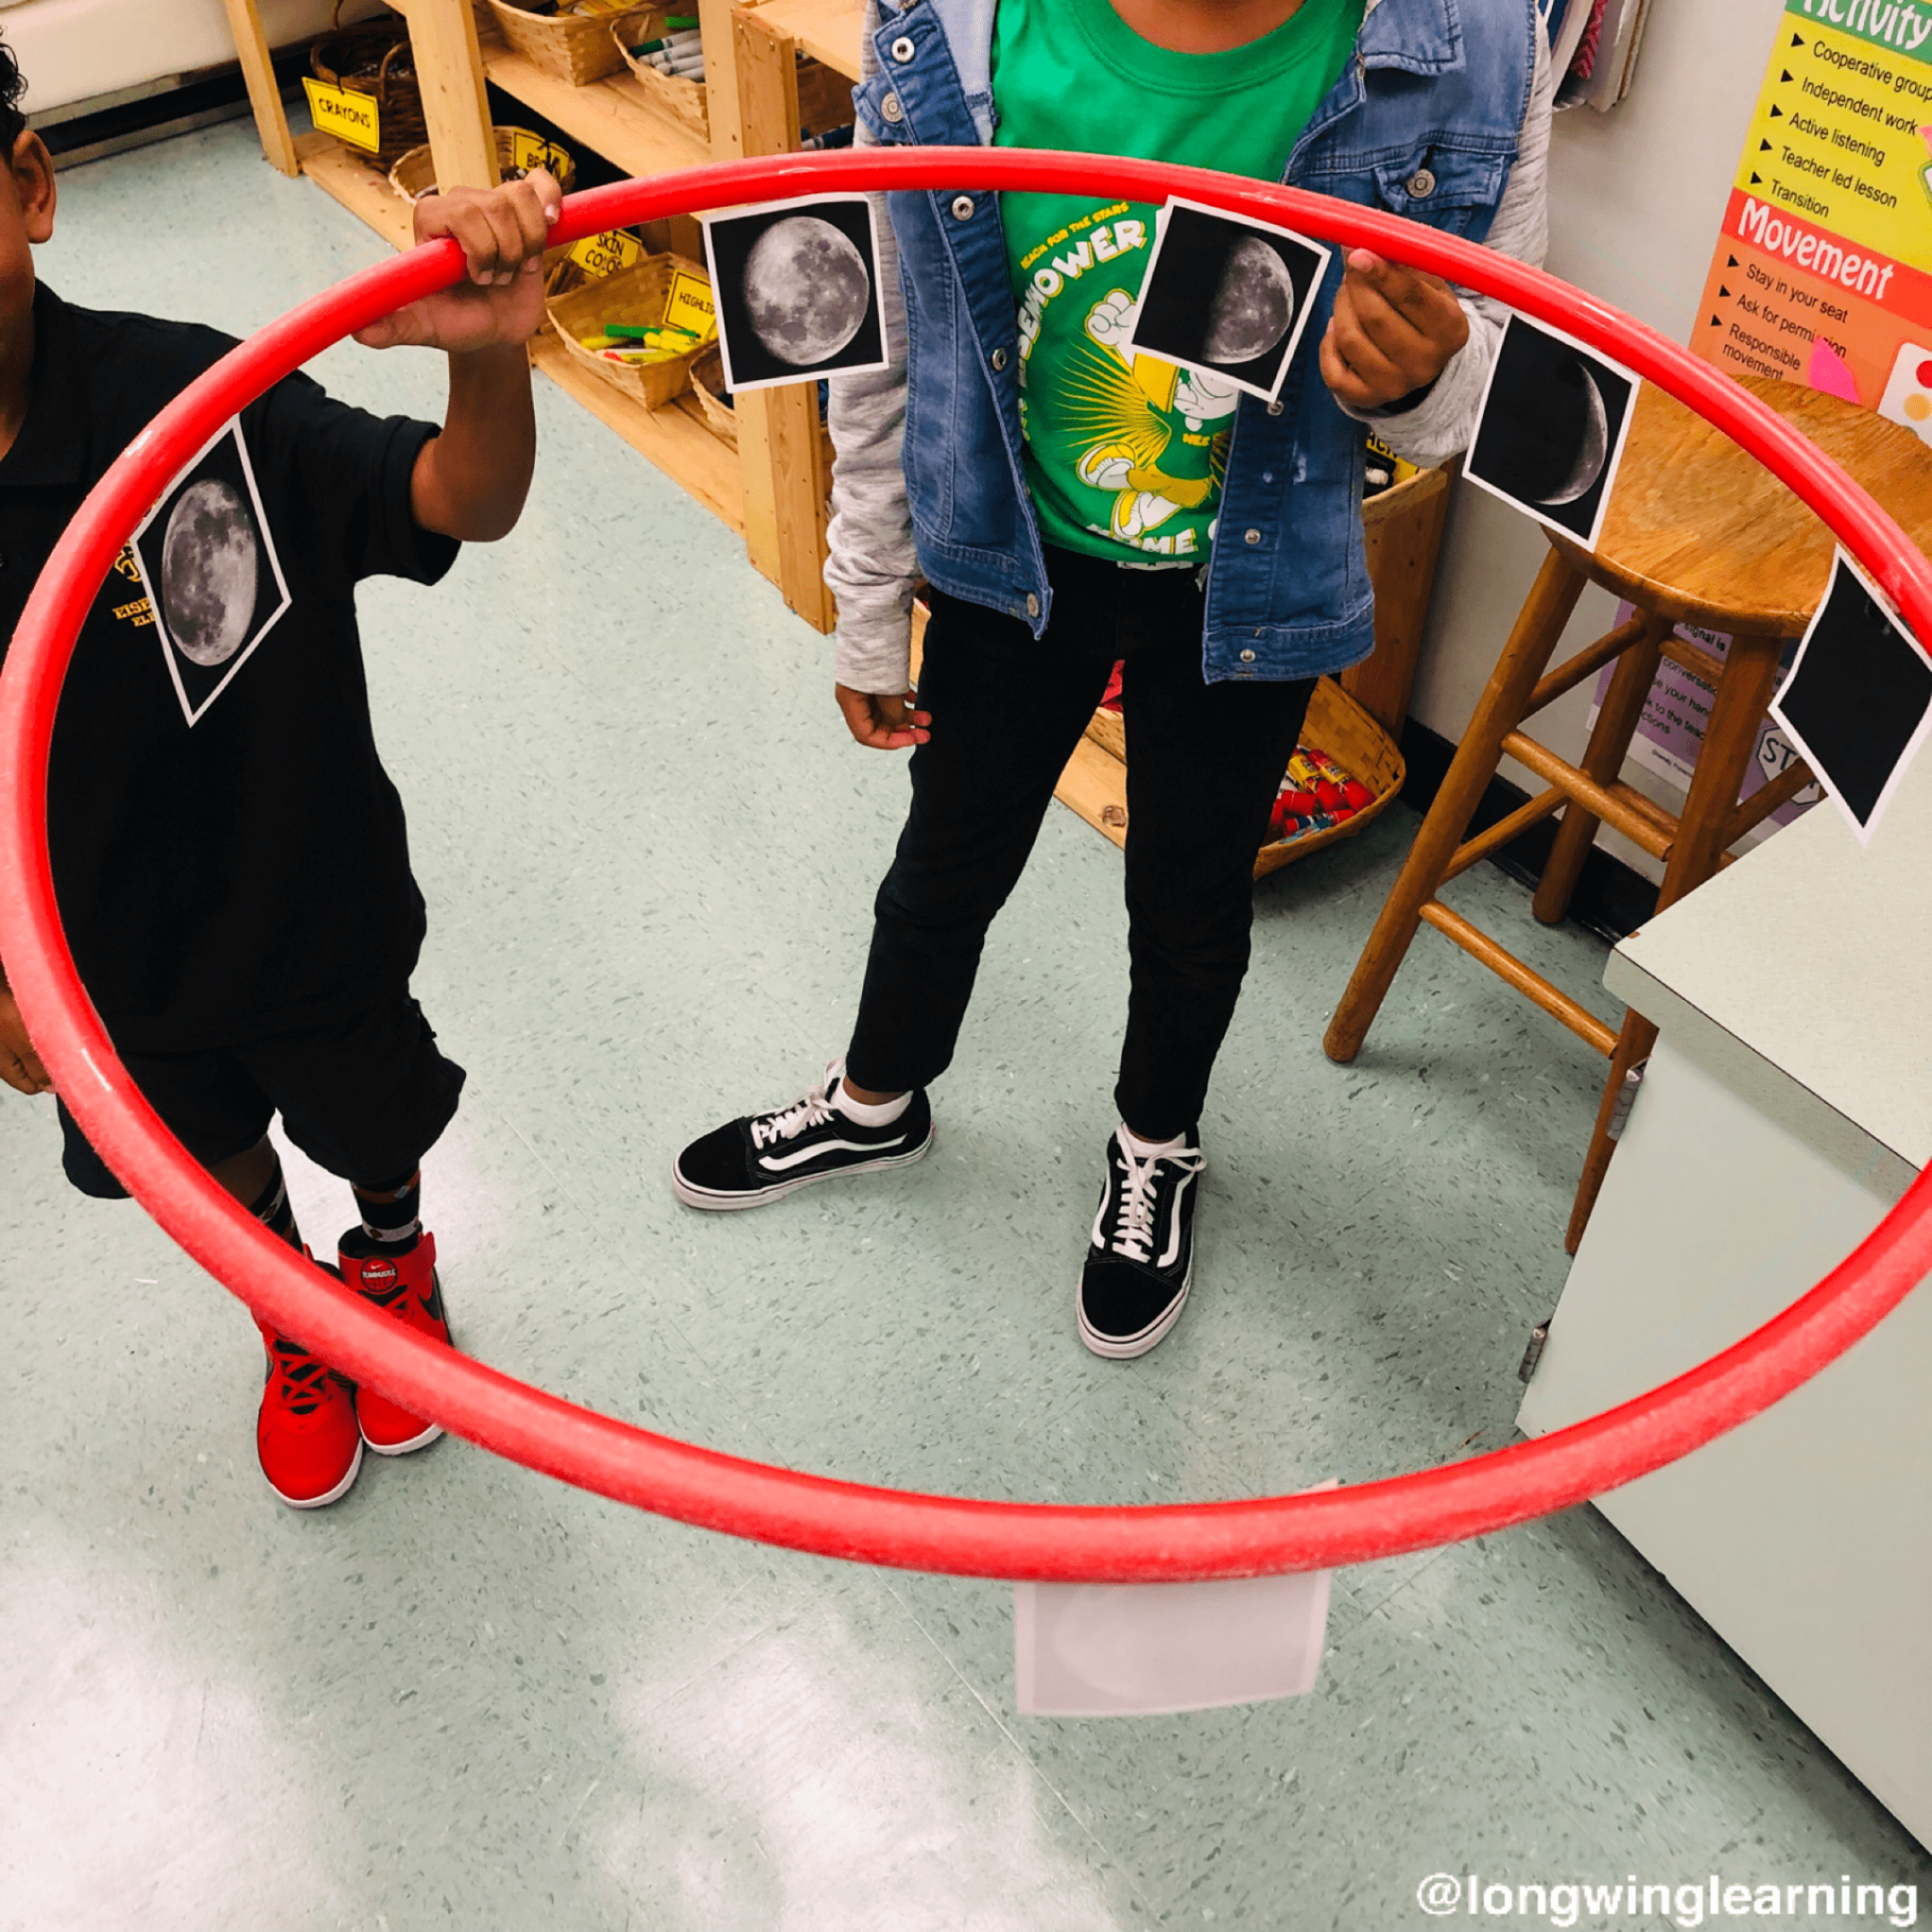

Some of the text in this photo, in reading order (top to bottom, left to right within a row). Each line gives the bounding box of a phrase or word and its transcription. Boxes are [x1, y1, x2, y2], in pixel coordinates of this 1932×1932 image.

[1813, 40, 1893, 85] Cooperative
[318, 97, 371, 129] CRAYONS
[1801, 76, 1919, 137] Independent work
[1789, 111, 1886, 168] Active listening
[1771, 178, 1829, 218] Transition
[1781, 145, 1898, 209] Teacher led lesson
[1046, 228, 1070, 247] FOR
[1068, 215, 1091, 233] THE
[1091, 201, 1129, 224] STARS
[1738, 197, 1894, 301] Movement
[1737, 293, 1760, 317] Ask
[1761, 305, 1780, 325] for
[1746, 262, 1849, 325] Stay in your seat
[1723, 342, 1784, 381] movement
[1728, 323, 1802, 372] Responsible
